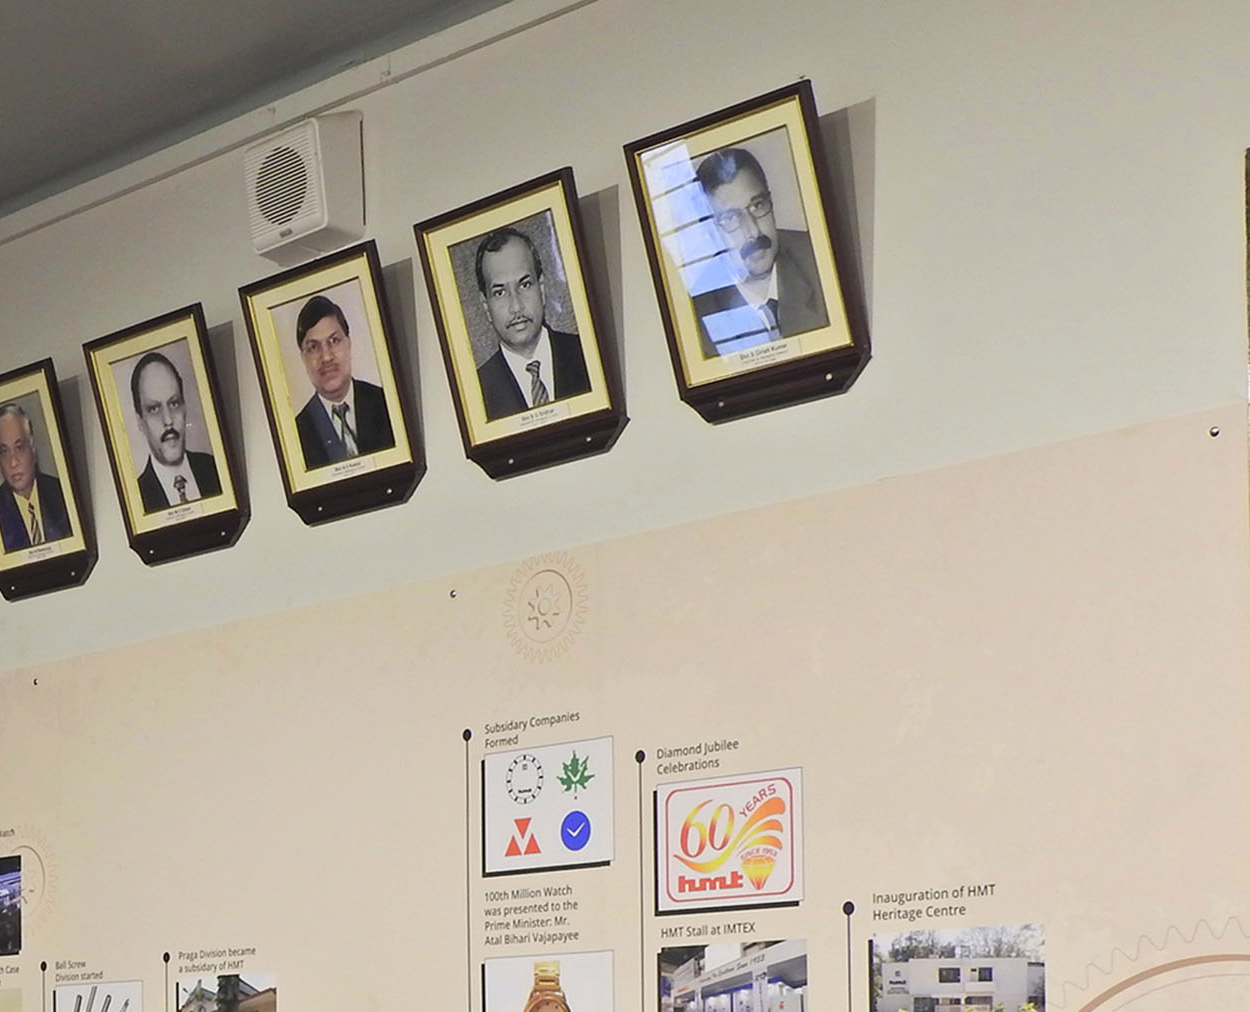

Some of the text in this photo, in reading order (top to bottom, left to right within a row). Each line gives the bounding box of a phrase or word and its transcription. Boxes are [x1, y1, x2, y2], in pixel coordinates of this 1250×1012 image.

[484, 712, 580, 735] Subsidary Companies
[485, 735, 518, 749] Formed
[657, 739, 739, 760] Diamond Jubilee
[657, 757, 720, 775] Celebrations
[680, 783, 777, 858] 60 YEARS
[678, 870, 744, 893] hmt
[485, 885, 573, 901] 100th Million Watch
[872, 884, 996, 905] Inauguration of HMT
[484, 900, 579, 917] was presented to the
[872, 905, 966, 922] Heritage Centre
[484, 921, 511, 931] Prime
[554, 917, 570, 926] Mr.
[661, 922, 756, 938] HMT Stall at IMTEX
[484, 930, 579, 946] Atal Bihari Vajapayee
[178, 947, 256, 961] Praga Division became
[5, 966, 19, 974] Case
[55, 960, 86, 970] Ball Screw
[219, 961, 226, 970] of
[227, 960, 244, 969] HMT
[55, 971, 103, 982] Division started
